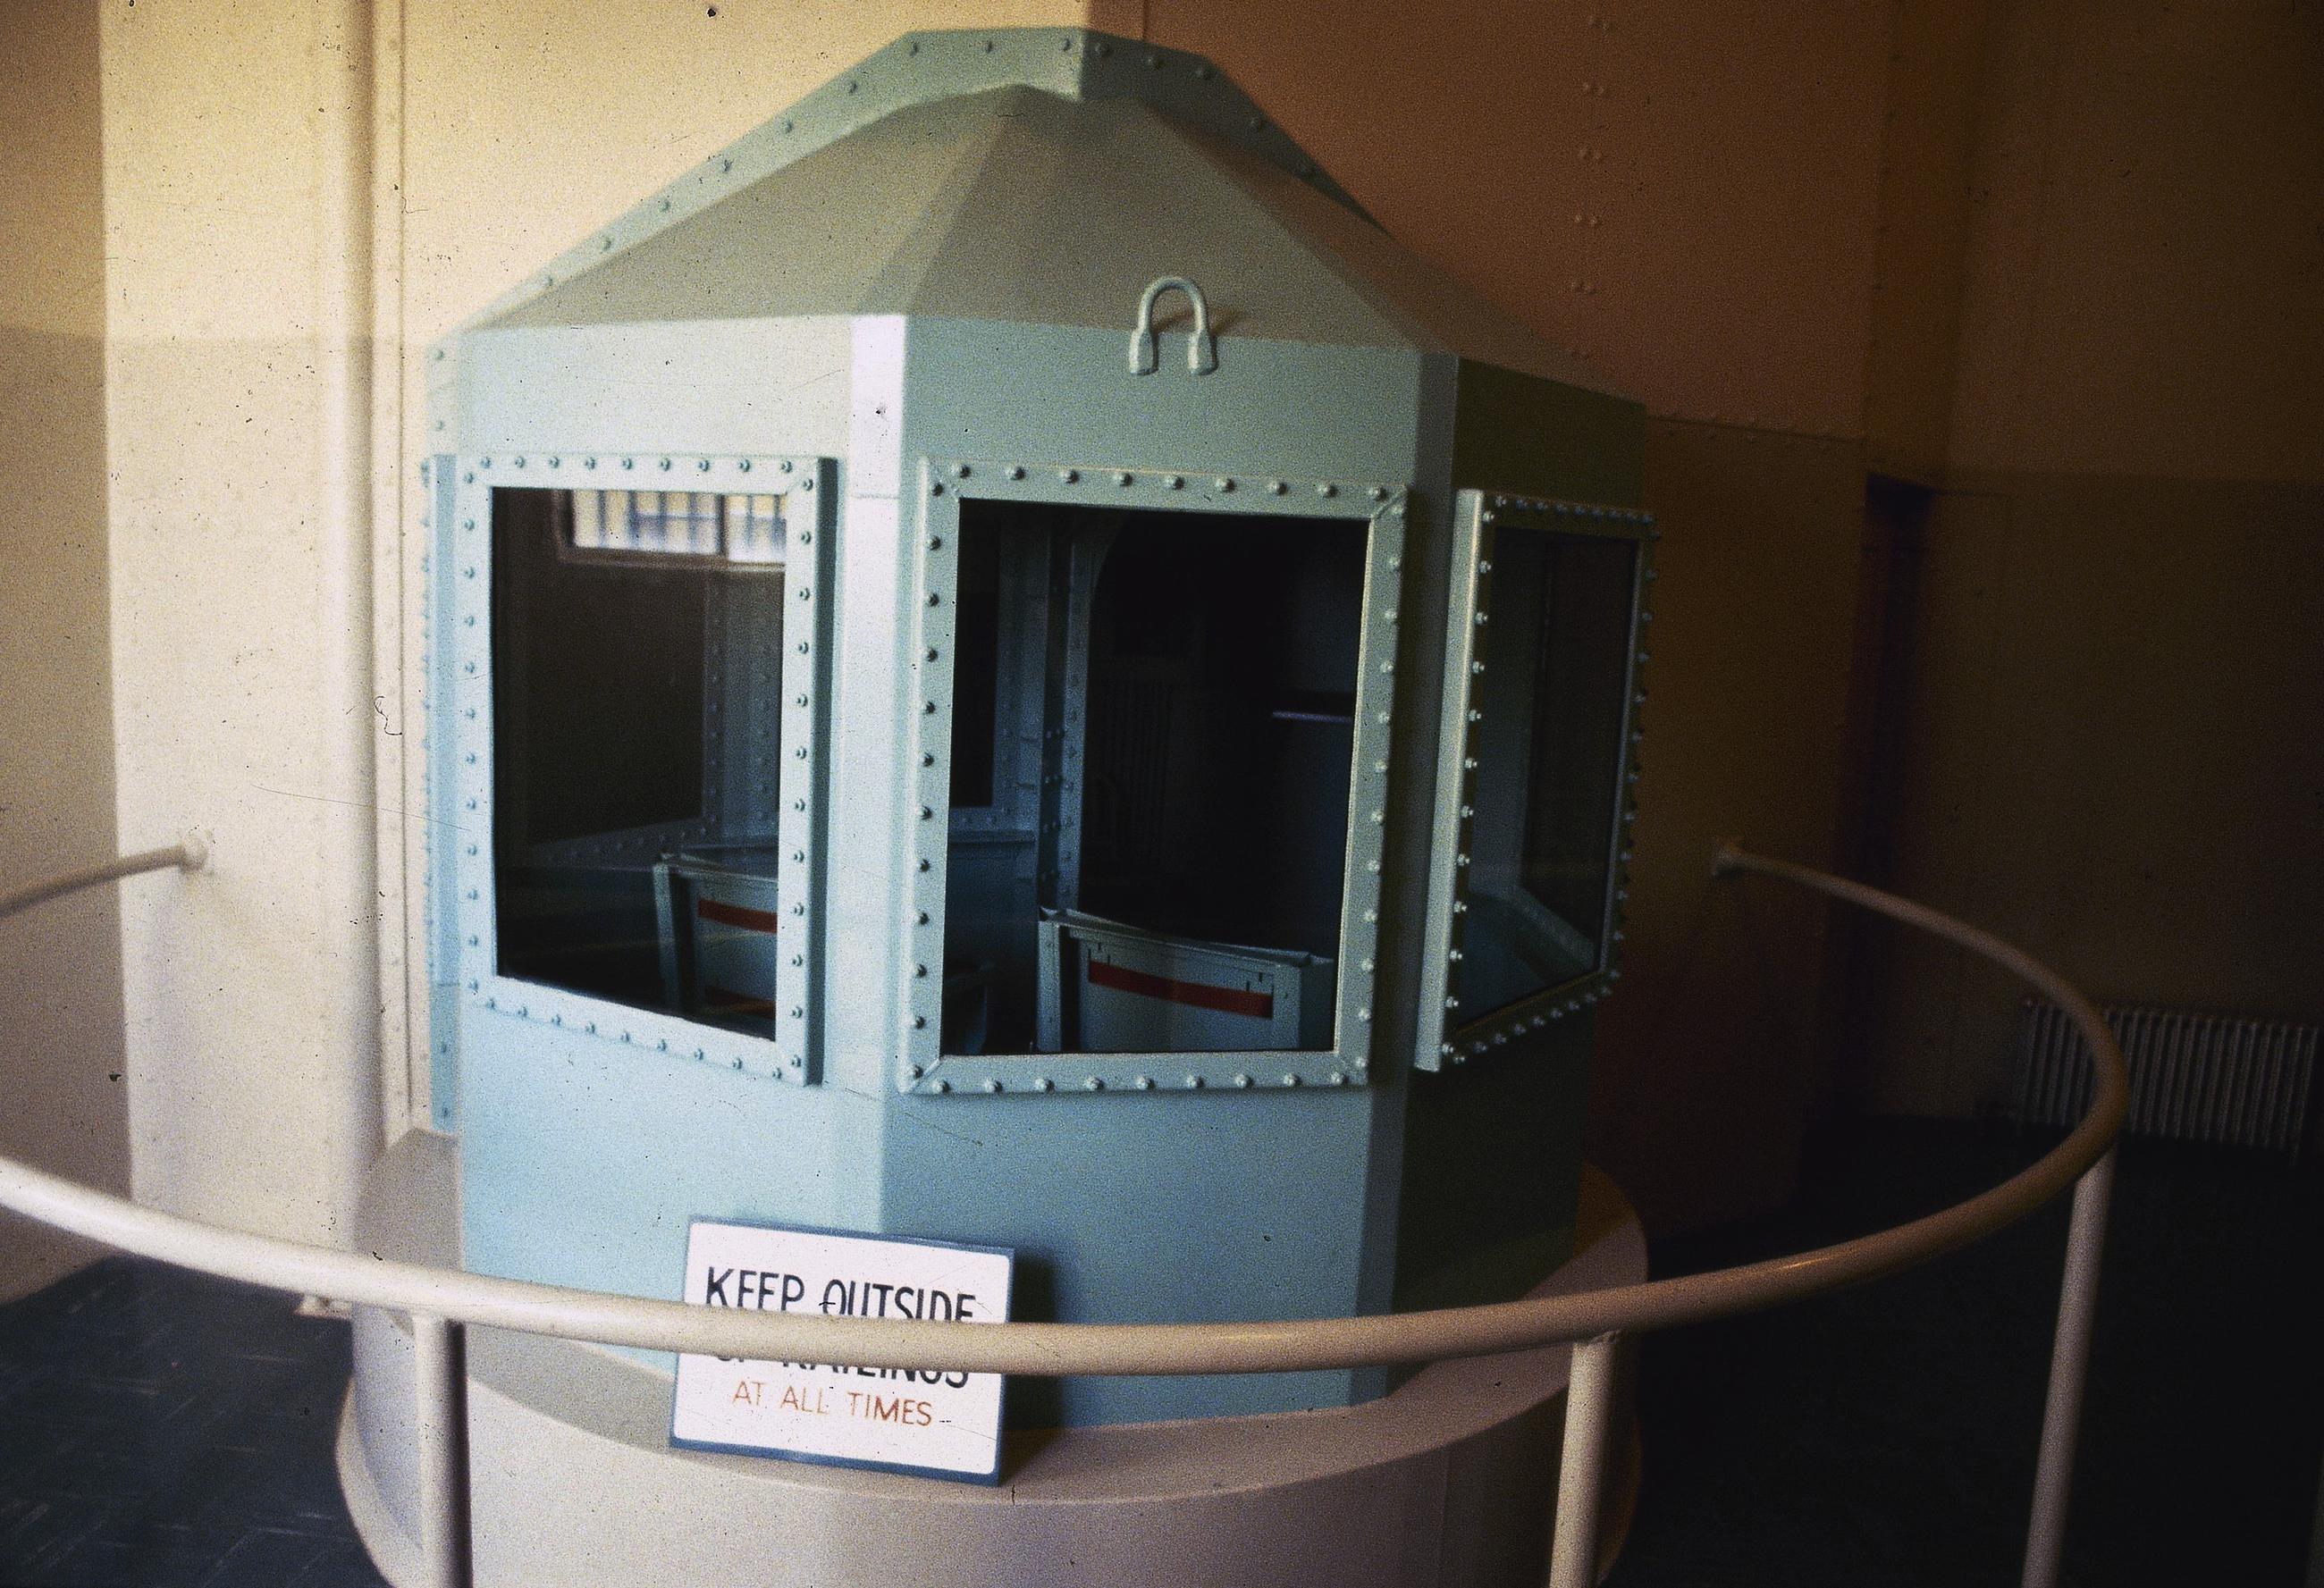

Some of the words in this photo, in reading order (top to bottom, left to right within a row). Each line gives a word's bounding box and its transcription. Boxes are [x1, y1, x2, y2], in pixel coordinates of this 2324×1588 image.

[706, 1265, 805, 1312] KEEP
[822, 1278, 977, 1322] OUTSIDE
[733, 1381, 766, 1407] AT
[779, 1385, 830, 1416] ALL
[847, 1391, 933, 1427] TIMES
